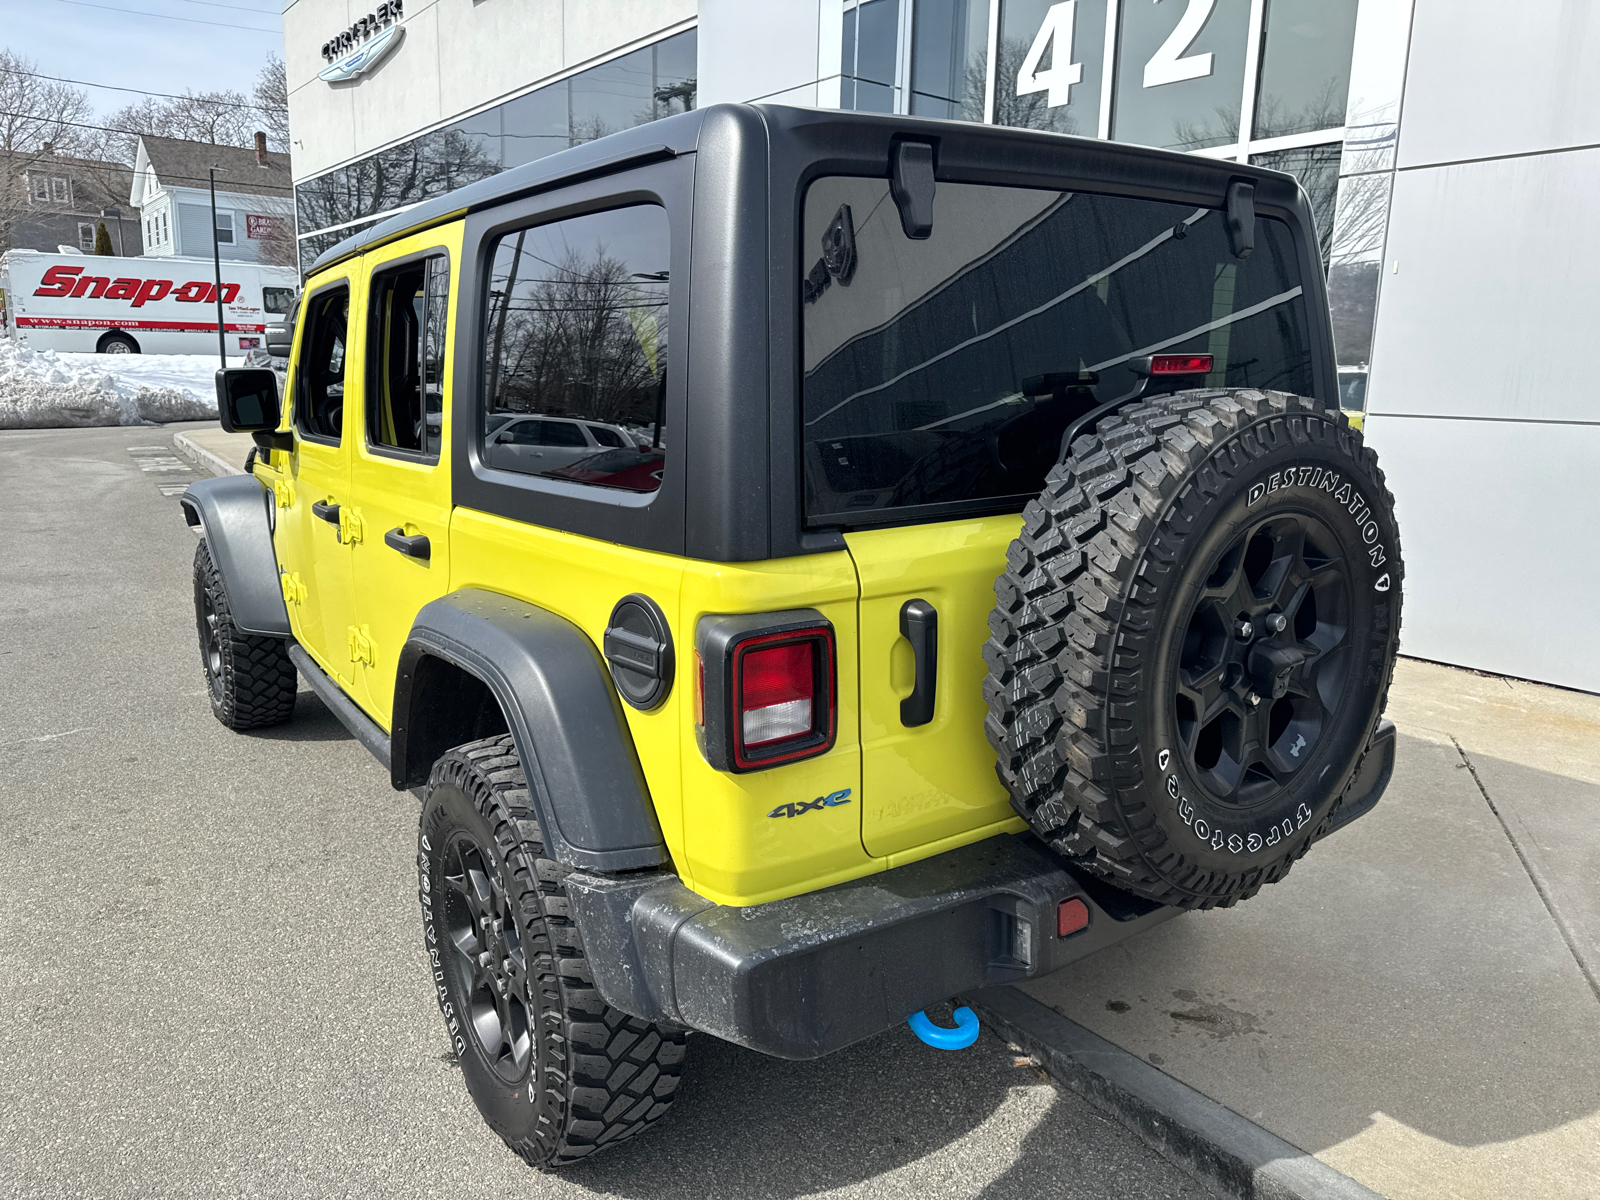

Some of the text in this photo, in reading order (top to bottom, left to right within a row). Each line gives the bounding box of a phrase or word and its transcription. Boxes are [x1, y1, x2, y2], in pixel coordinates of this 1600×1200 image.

[321, 0, 404, 59] CHRYSLER
[33, 265, 241, 308] Snap-on
[29, 318, 139, 326] www.snapon.com
[1247, 466, 1386, 568] DESTINATION
[420, 853, 466, 1057] DESTINATION
